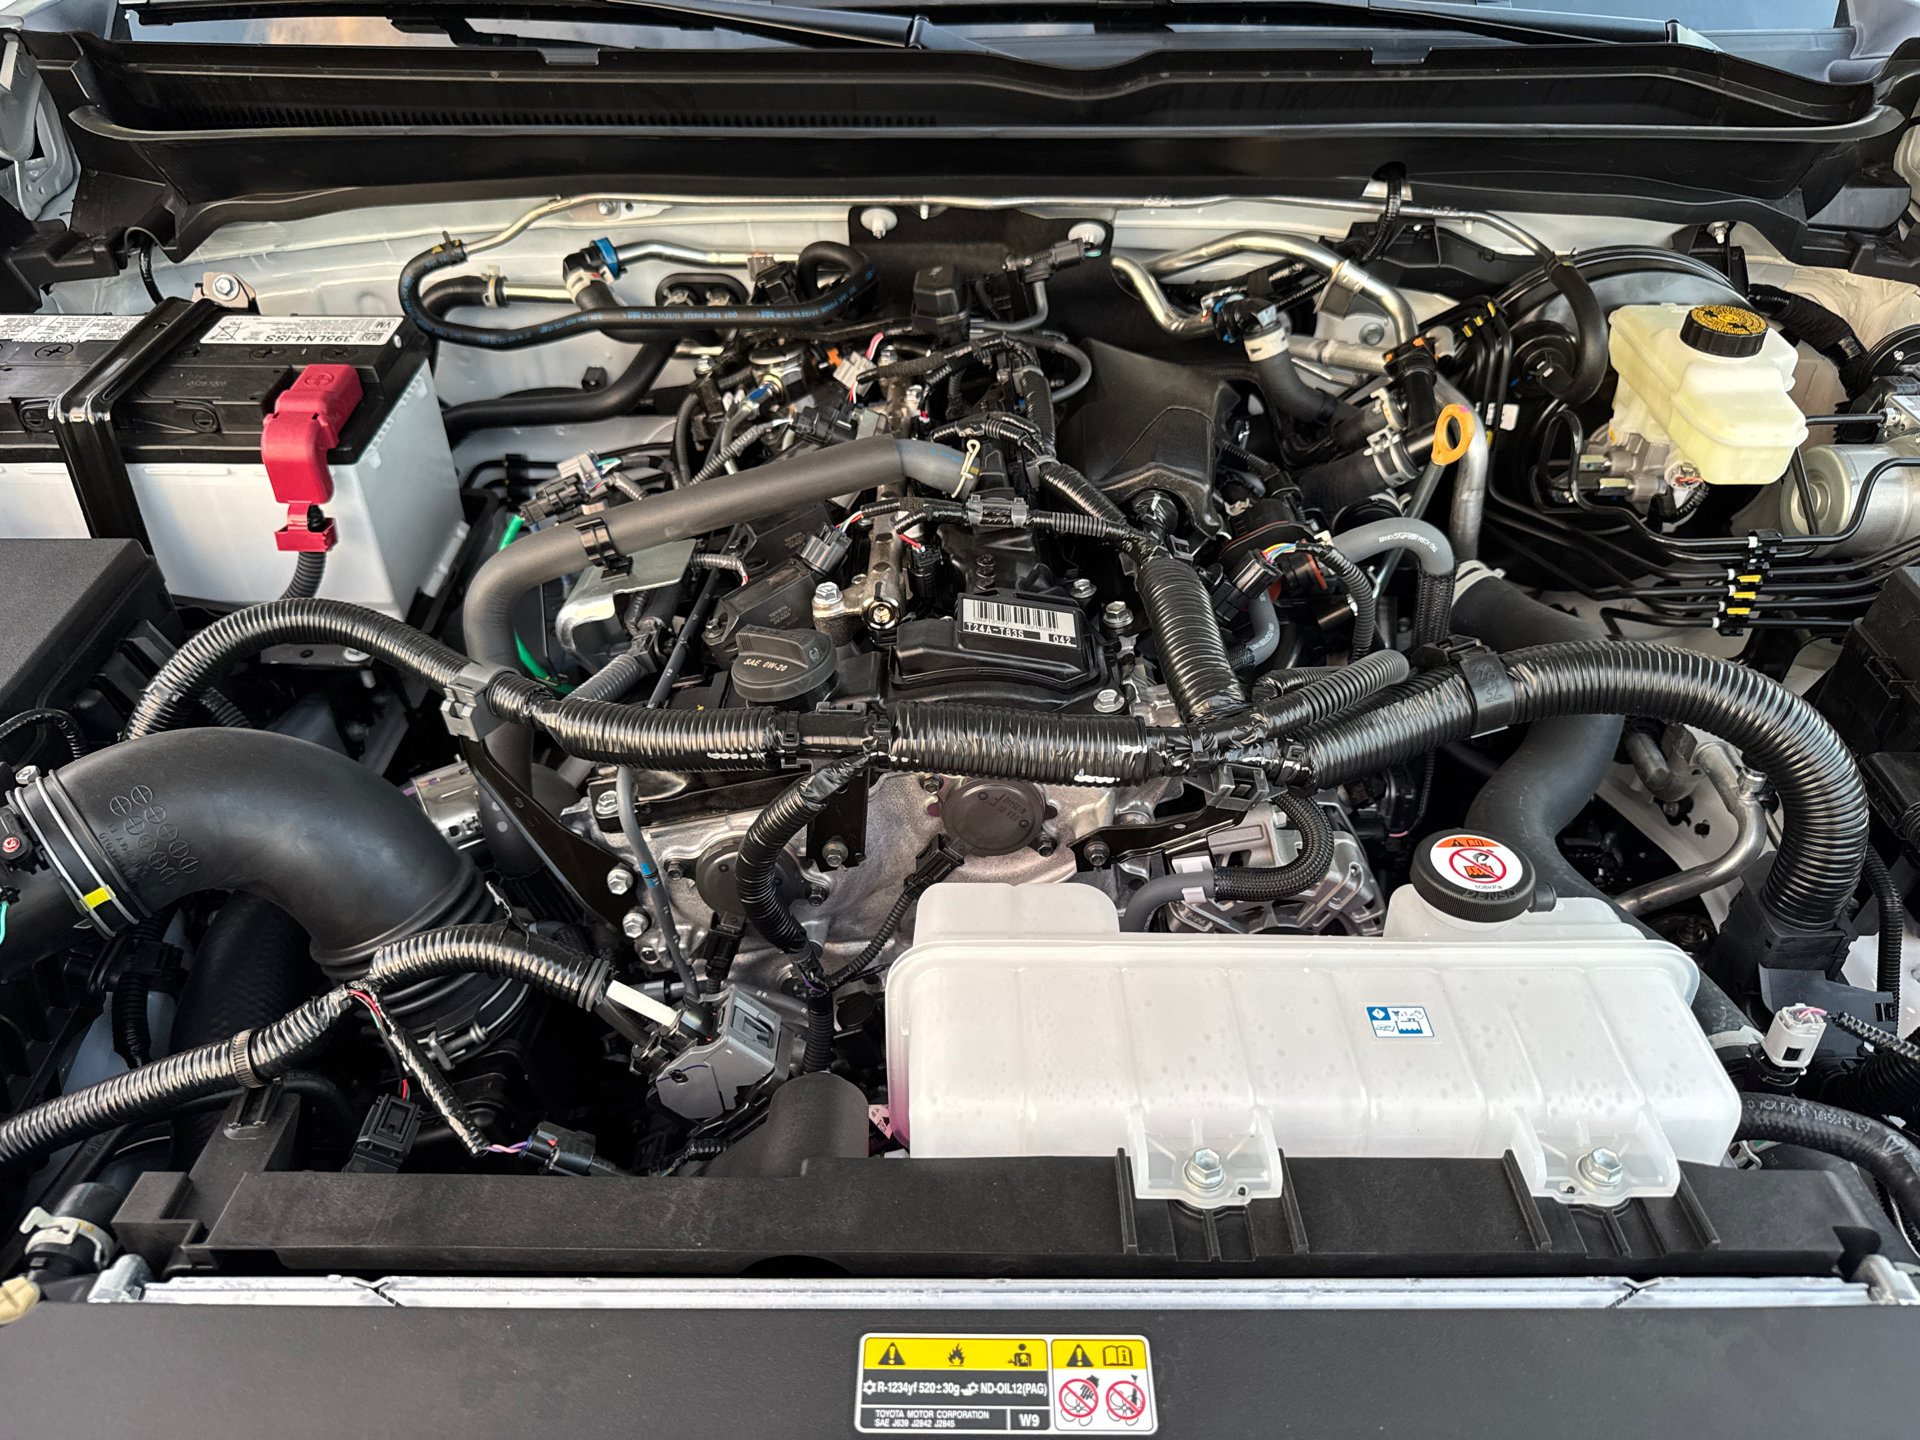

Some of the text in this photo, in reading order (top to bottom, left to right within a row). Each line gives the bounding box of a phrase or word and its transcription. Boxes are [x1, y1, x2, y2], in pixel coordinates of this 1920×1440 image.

[264, 334, 354, 343] 395LN4-ISS
[966, 623, 1072, 645] T24A-T83S 042
[743, 657, 789, 672] SAE 0W-20
[876, 1380, 1048, 1396] R-1234yf 520±30g ND-OIL12(PAG)
[875, 1409, 990, 1420] TOYOTA MOTOR CORPORATION
[1019, 1413, 1041, 1428] W9
[874, 1418, 956, 1429] SAE J639 J2842 J2845
